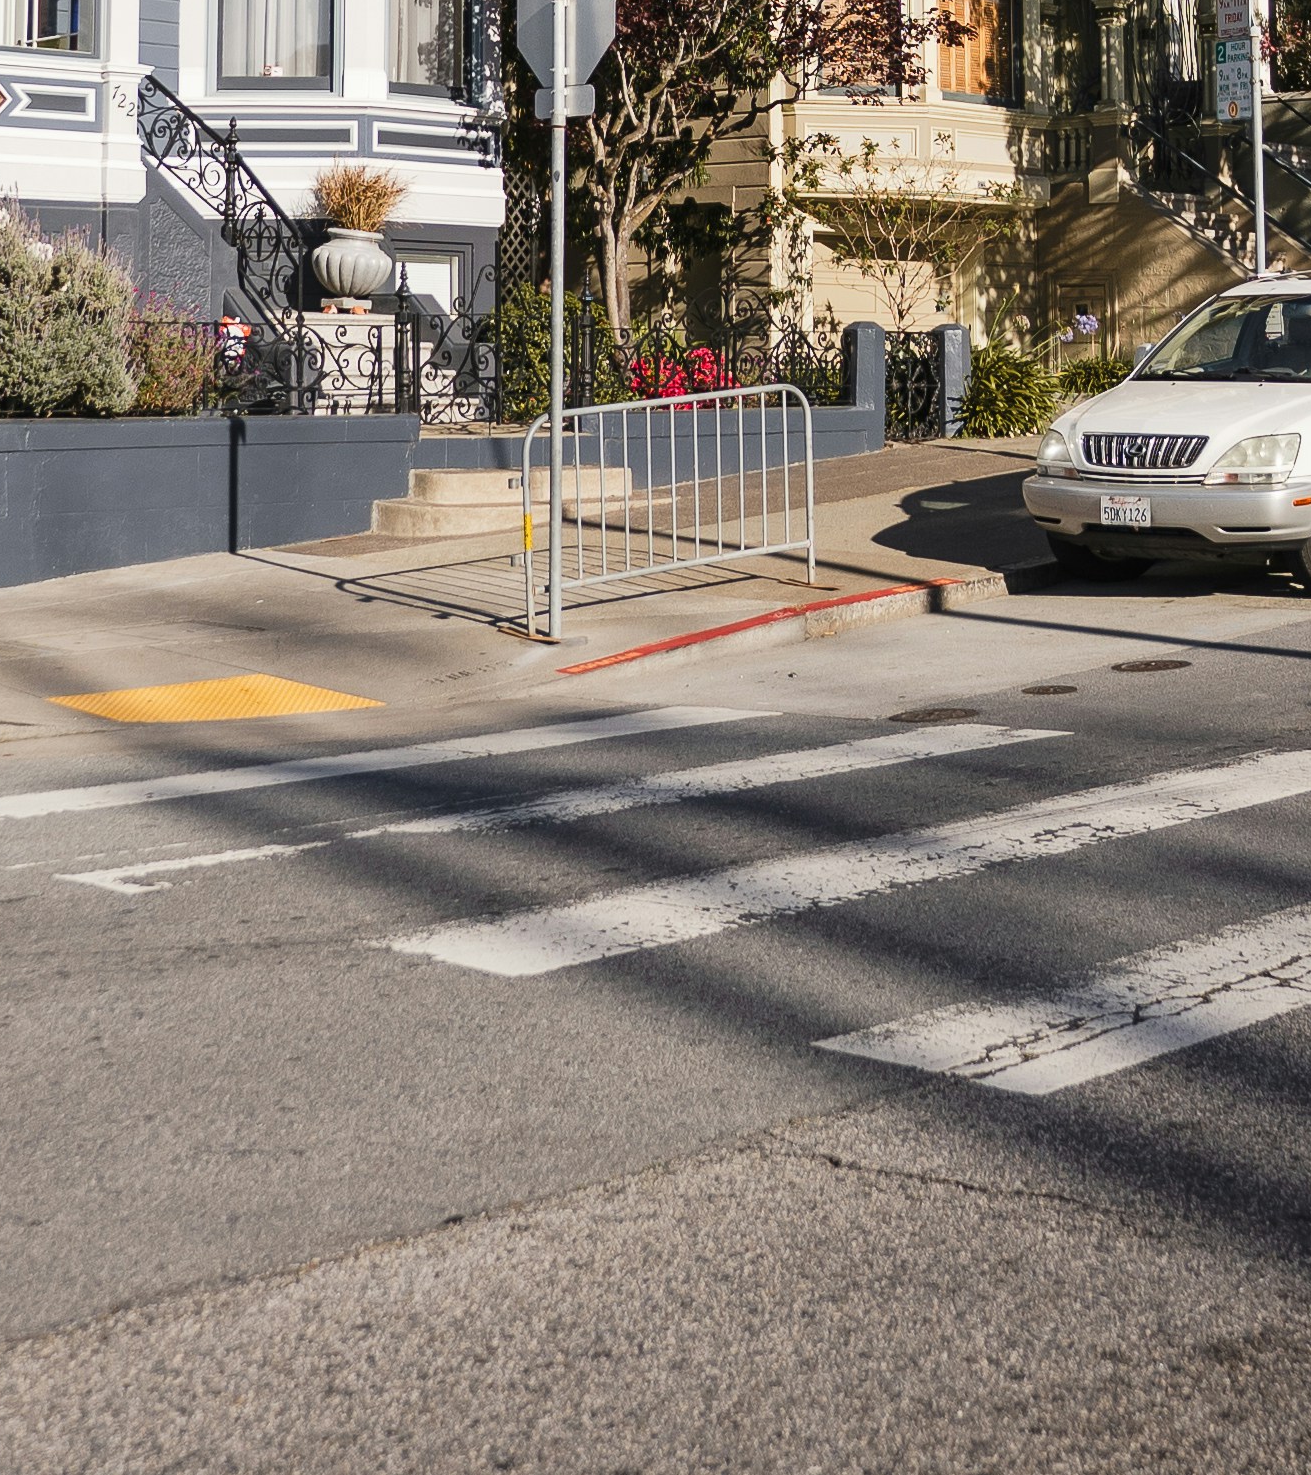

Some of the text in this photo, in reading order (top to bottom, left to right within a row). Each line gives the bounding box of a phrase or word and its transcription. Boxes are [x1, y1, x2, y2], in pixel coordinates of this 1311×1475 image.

[1225, 12, 1242, 24] FRIDAY
[1218, 42, 1245, 61] 2 HOUR
[1228, 52, 1249, 62] PARKING
[1103, 506, 1147, 522] 5DKY126
